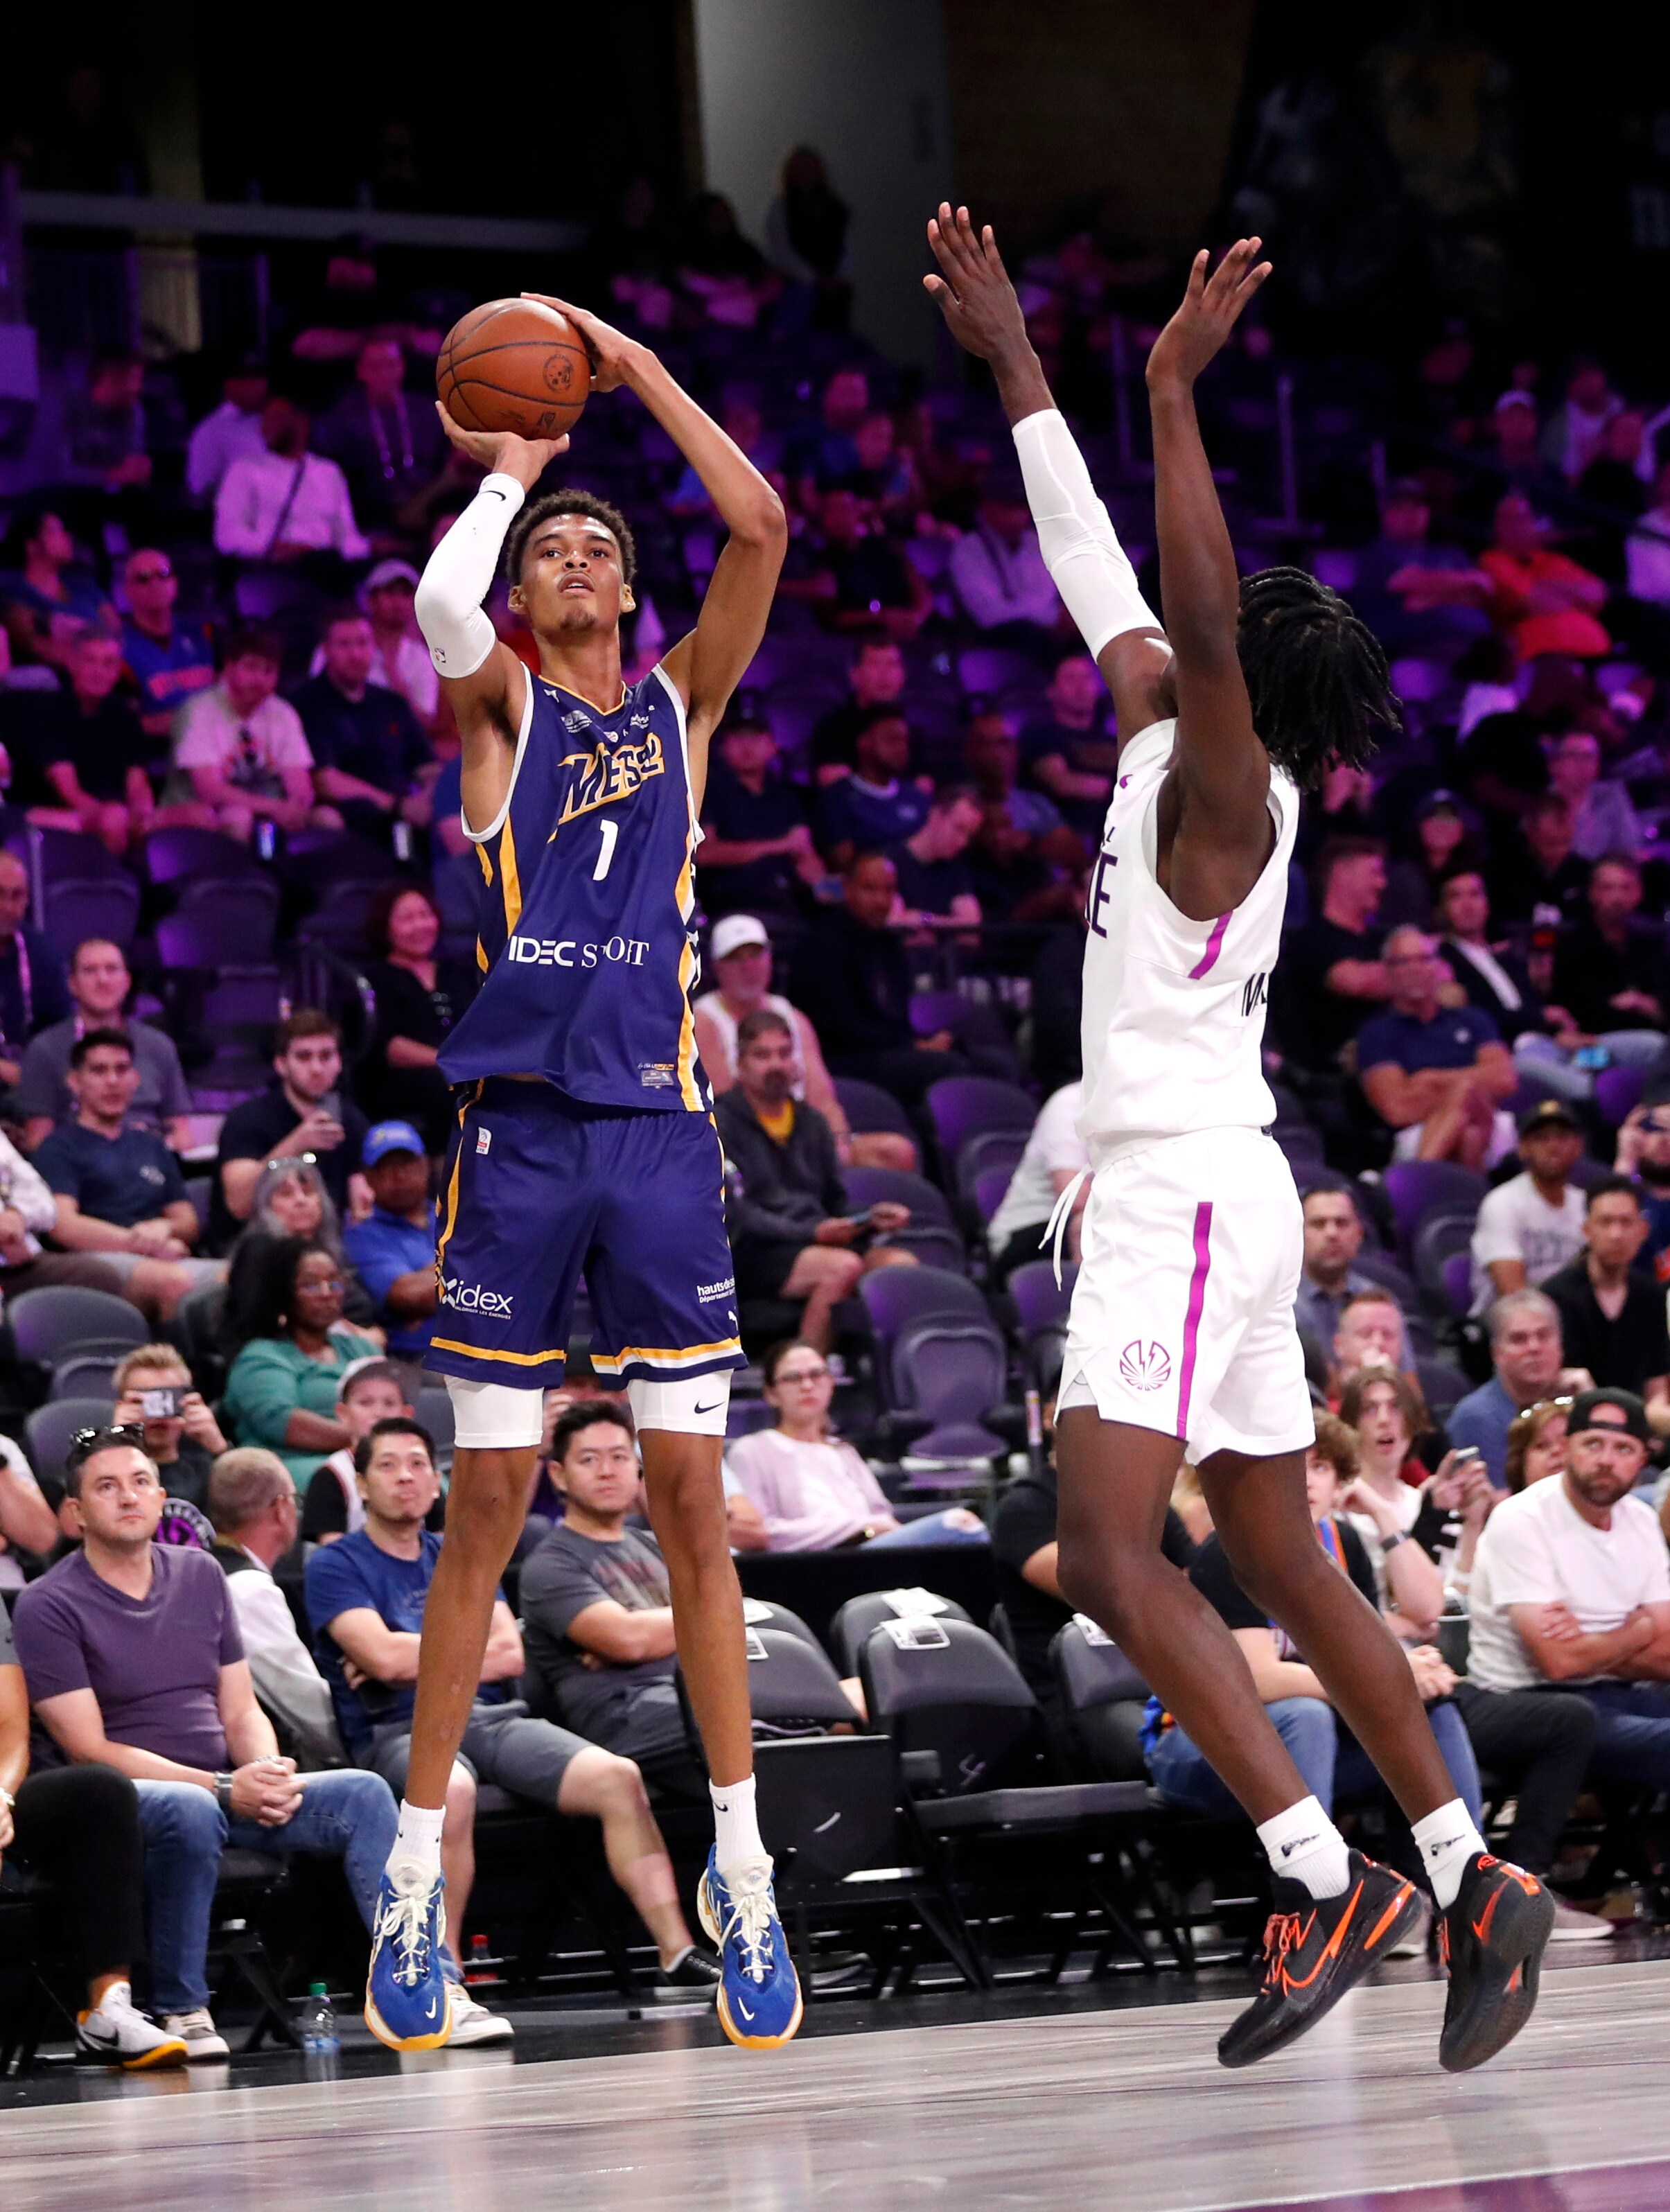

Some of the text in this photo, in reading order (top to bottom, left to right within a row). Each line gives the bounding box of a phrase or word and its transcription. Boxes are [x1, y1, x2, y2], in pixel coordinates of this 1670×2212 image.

[592, 819, 619, 881] 1
[508, 936, 577, 967] IDEC
[455, 1280, 513, 1314] idex
